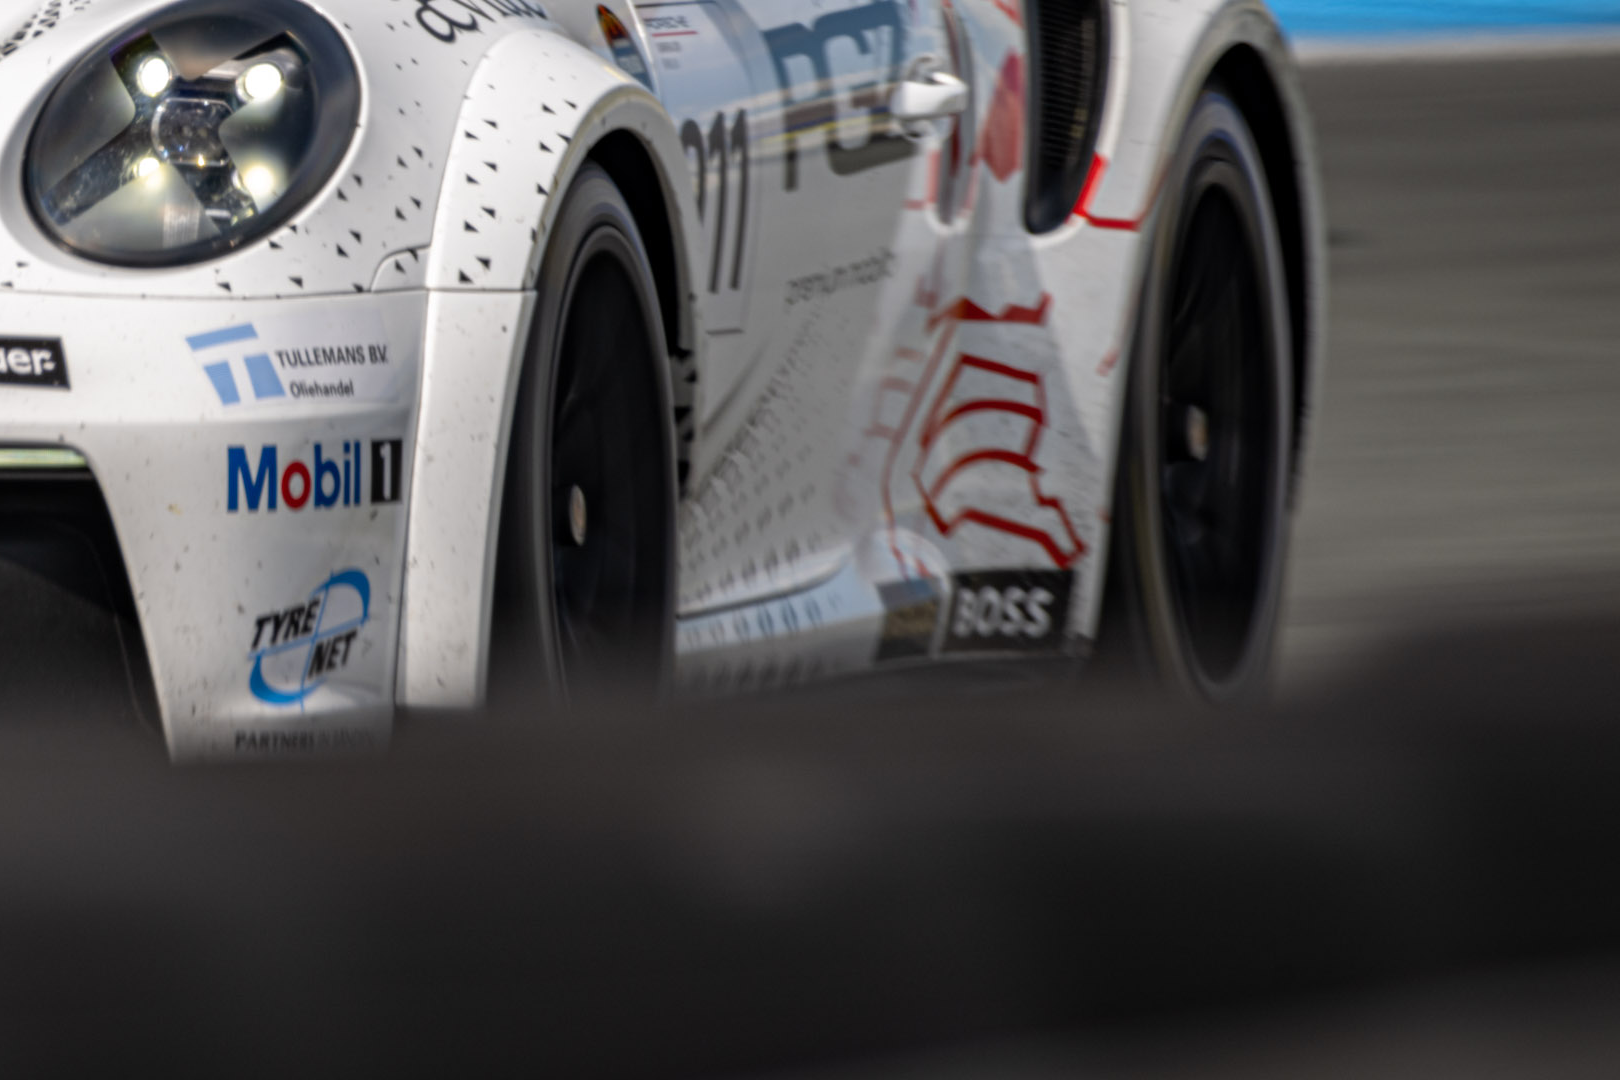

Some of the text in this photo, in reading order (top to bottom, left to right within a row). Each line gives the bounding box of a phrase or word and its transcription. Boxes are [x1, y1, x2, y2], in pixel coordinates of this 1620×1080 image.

[275, 343, 365, 369] TULLEMANS
[289, 379, 354, 399] Oliehandel
[227, 438, 362, 514] Mobil
[251, 597, 321, 651] TYRE
[307, 628, 358, 680] NET
